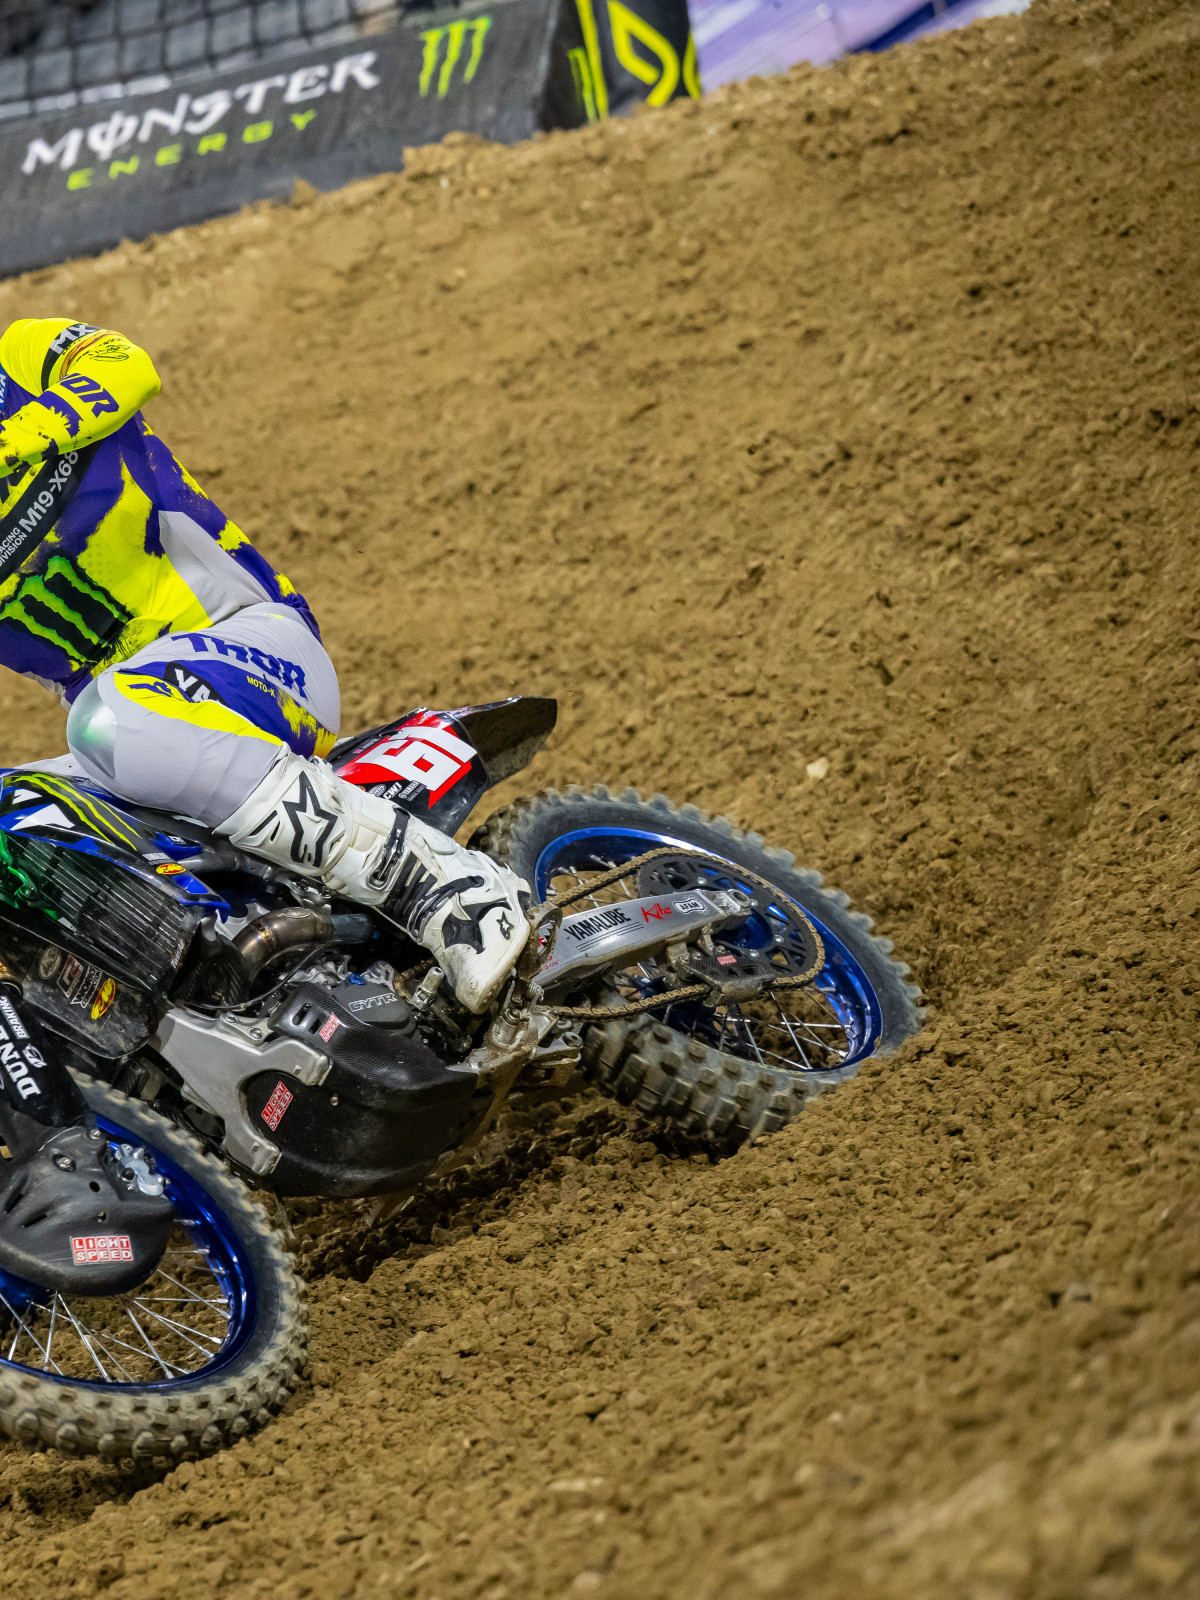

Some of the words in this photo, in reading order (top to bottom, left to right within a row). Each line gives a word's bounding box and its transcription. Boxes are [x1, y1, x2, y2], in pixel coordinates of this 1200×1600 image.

[67, 109, 317, 190] ENERGY
[19, 450, 79, 533] M19-X68
[171, 633, 308, 700] THOR
[247, 676, 275, 698] MOTO-X
[355, 726, 478, 791] 61
[641, 903, 673, 923] Kite
[680, 901, 699, 911] AFAM
[563, 907, 632, 941] YAMALUBE
[349, 993, 397, 1012] GYTR
[263, 1083, 287, 1120] LIGHT
[269, 1091, 293, 1130] SPEED
[74, 1236, 131, 1249] LIGHT
[75, 1249, 133, 1262] SPEED
